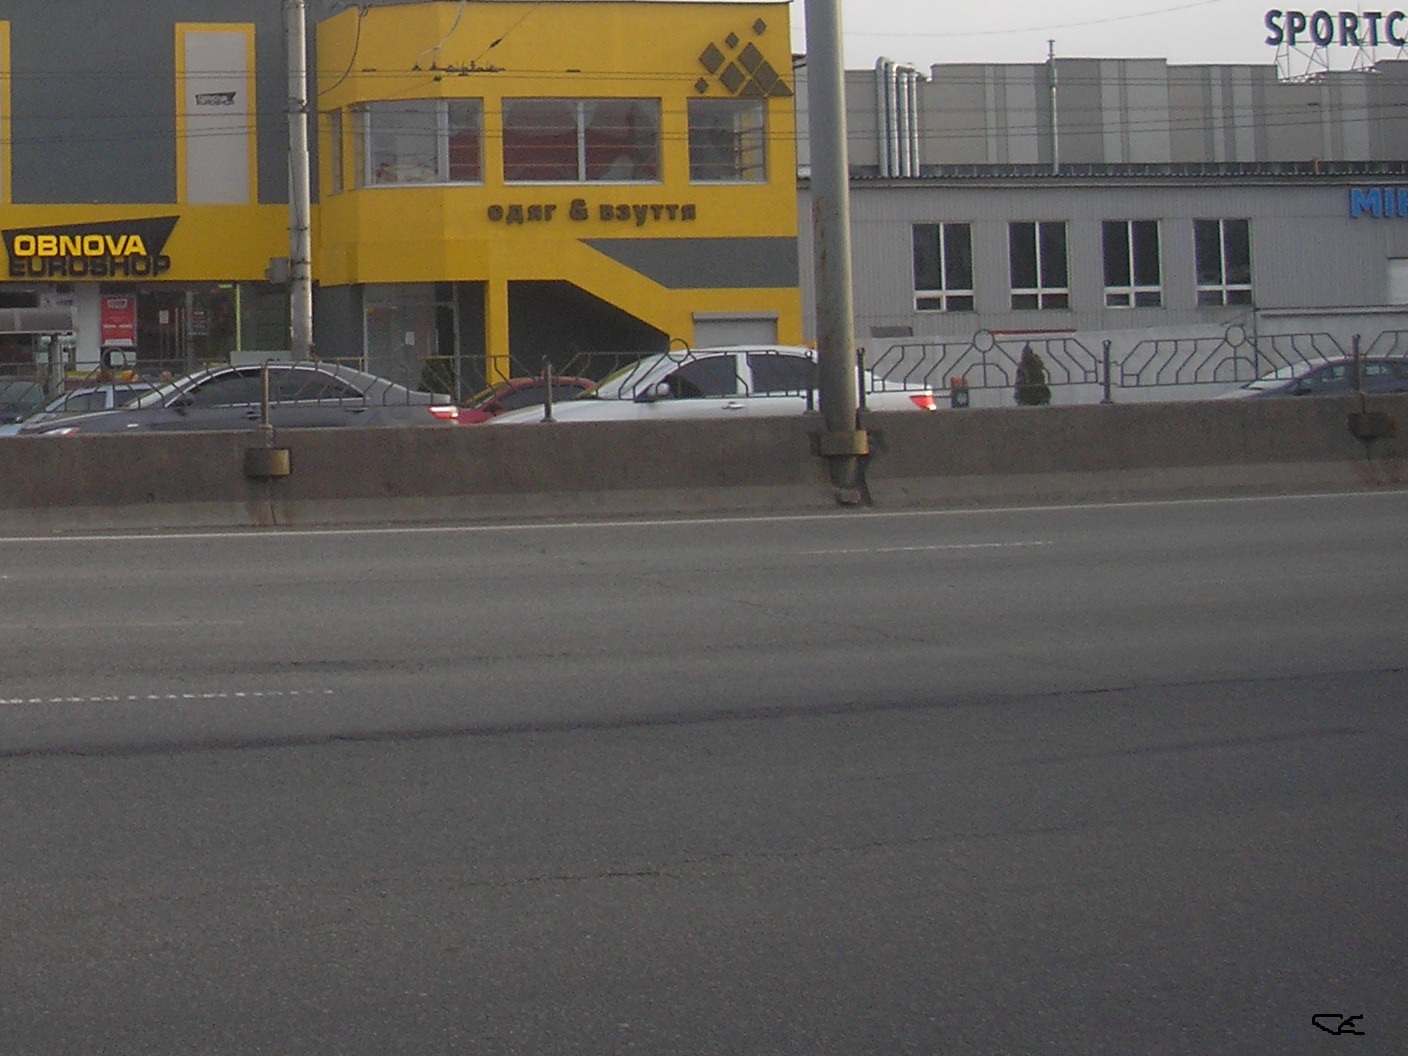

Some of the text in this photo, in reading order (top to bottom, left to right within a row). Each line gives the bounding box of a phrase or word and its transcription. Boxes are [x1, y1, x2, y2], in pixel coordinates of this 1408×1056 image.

[1264, 8, 1407, 47] SPORTC
[487, 198, 697, 227] одяг & взуття
[13, 234, 148, 257] OBNOVA
[9, 255, 172, 277] EUROSHOP
